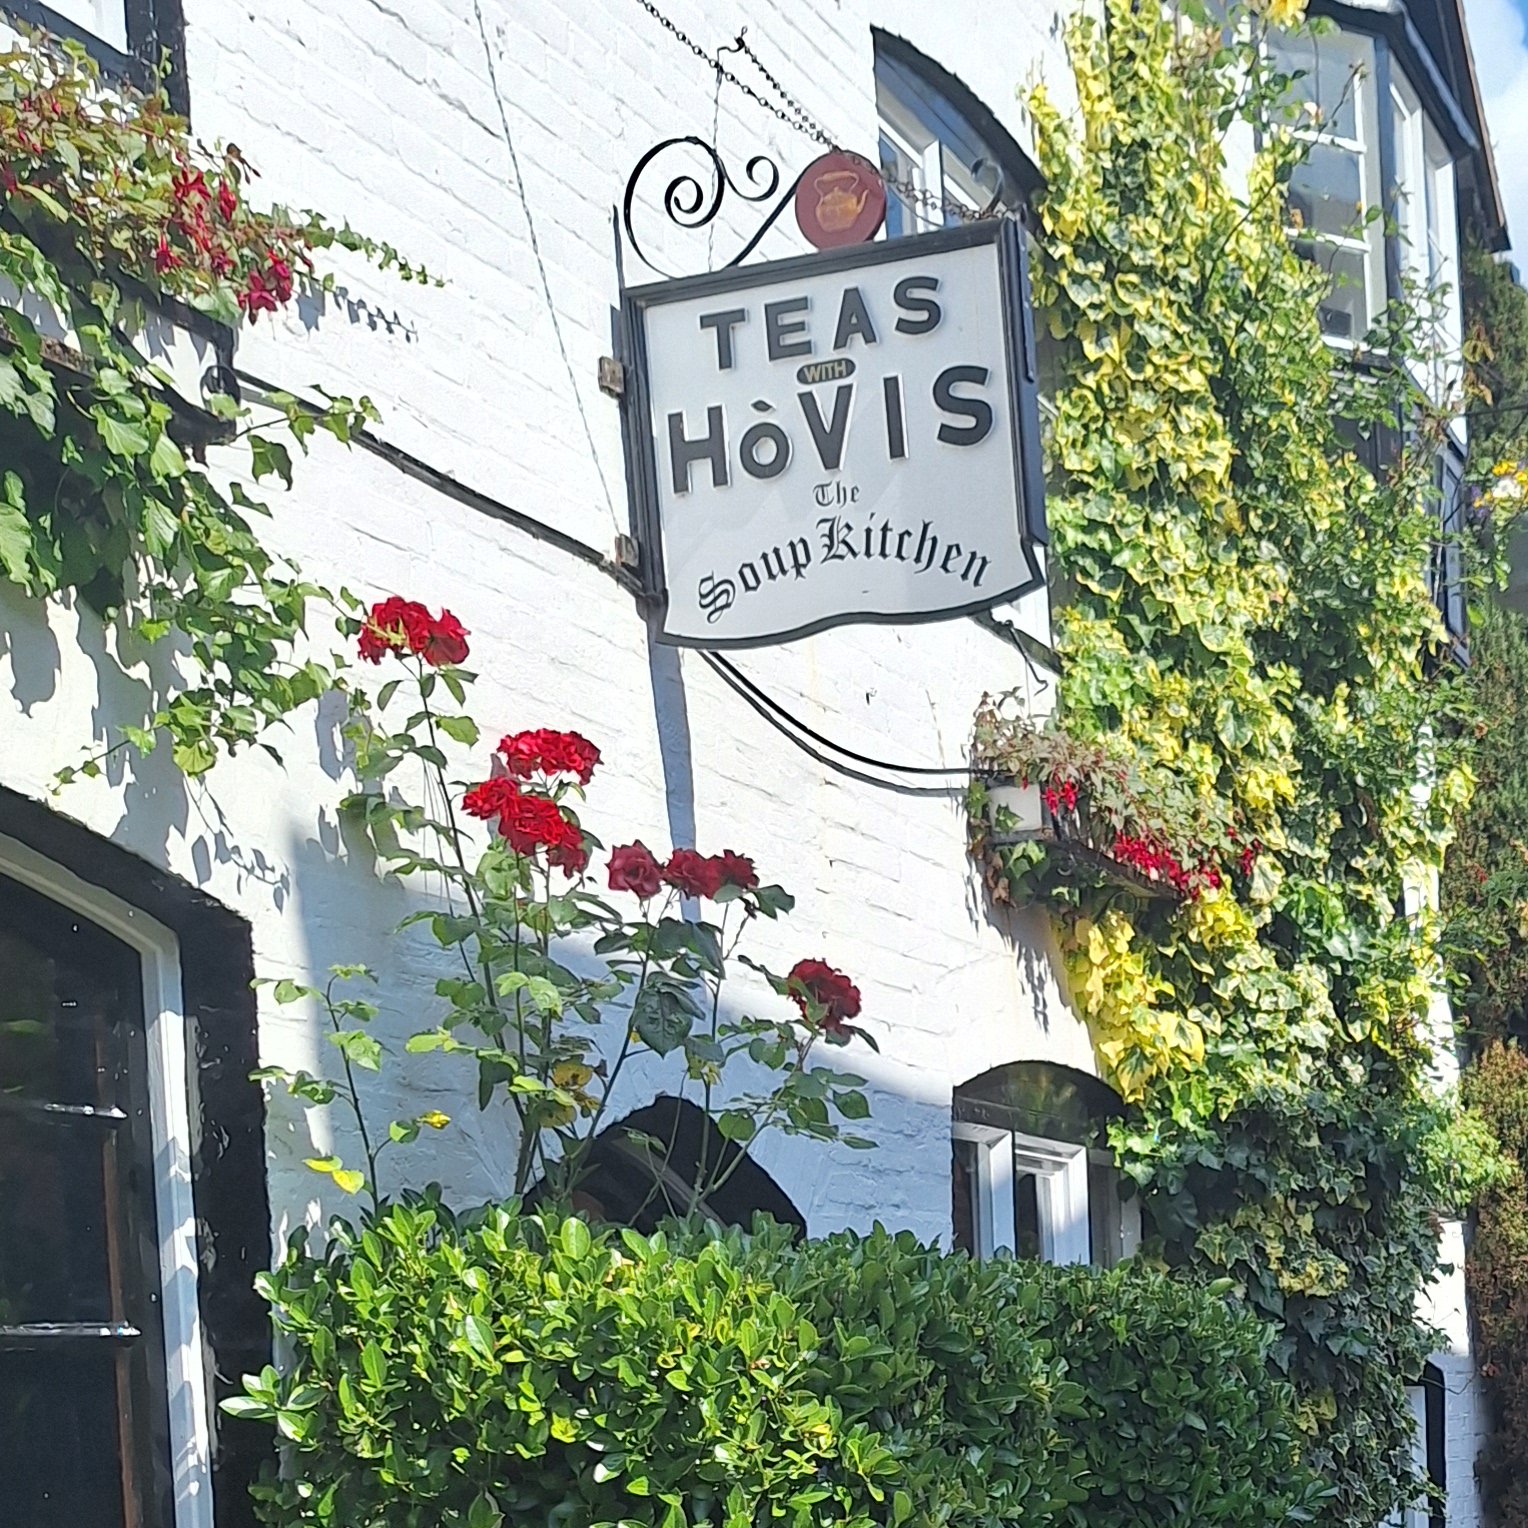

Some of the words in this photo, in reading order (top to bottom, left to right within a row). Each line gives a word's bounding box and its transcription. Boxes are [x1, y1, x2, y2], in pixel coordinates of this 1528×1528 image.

[699, 276, 942, 371] TEAS
[803, 360, 848, 383] WITH
[813, 480, 860, 509] The
[698, 536, 812, 624] Soup
[814, 511, 993, 588] Kitchen
